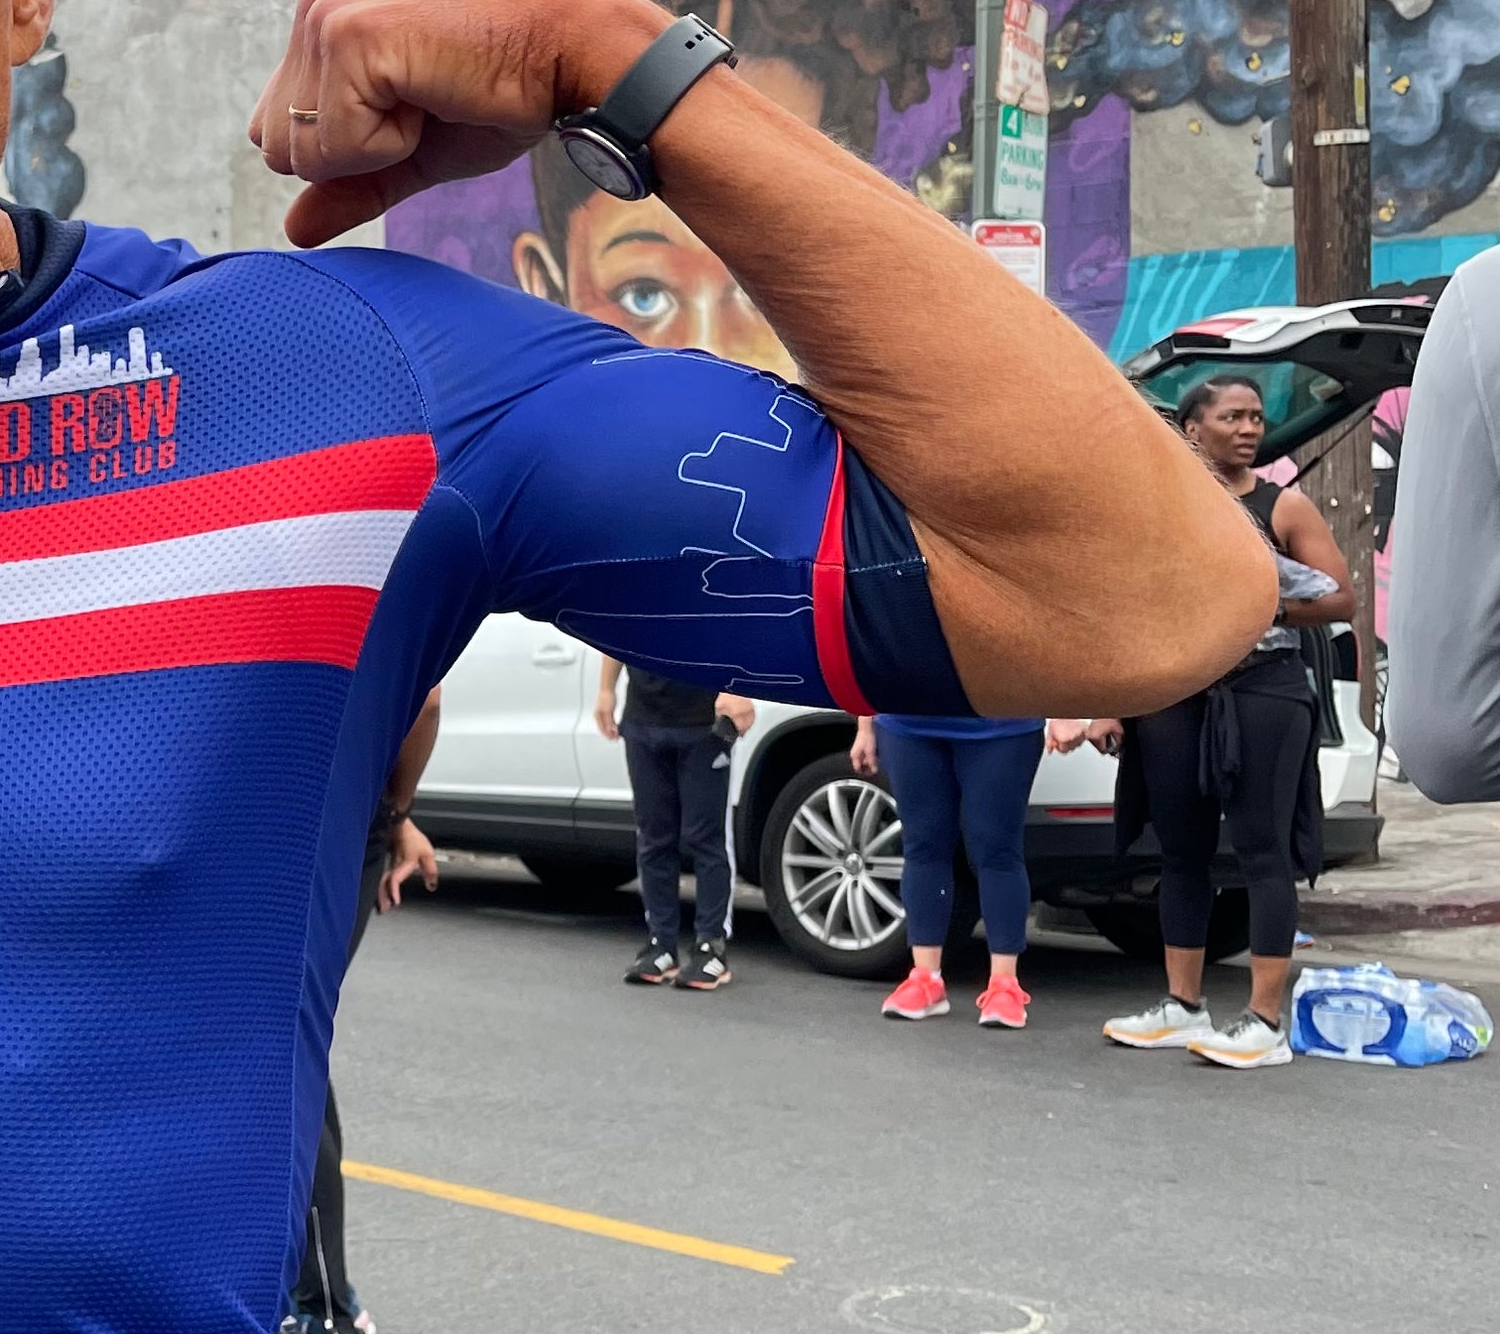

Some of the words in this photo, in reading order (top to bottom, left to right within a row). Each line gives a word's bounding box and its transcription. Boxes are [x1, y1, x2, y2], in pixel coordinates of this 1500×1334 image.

[1006, 108, 1019, 135] 4
[50, 375, 180, 456] ROW
[89, 440, 176, 484] CLUB
